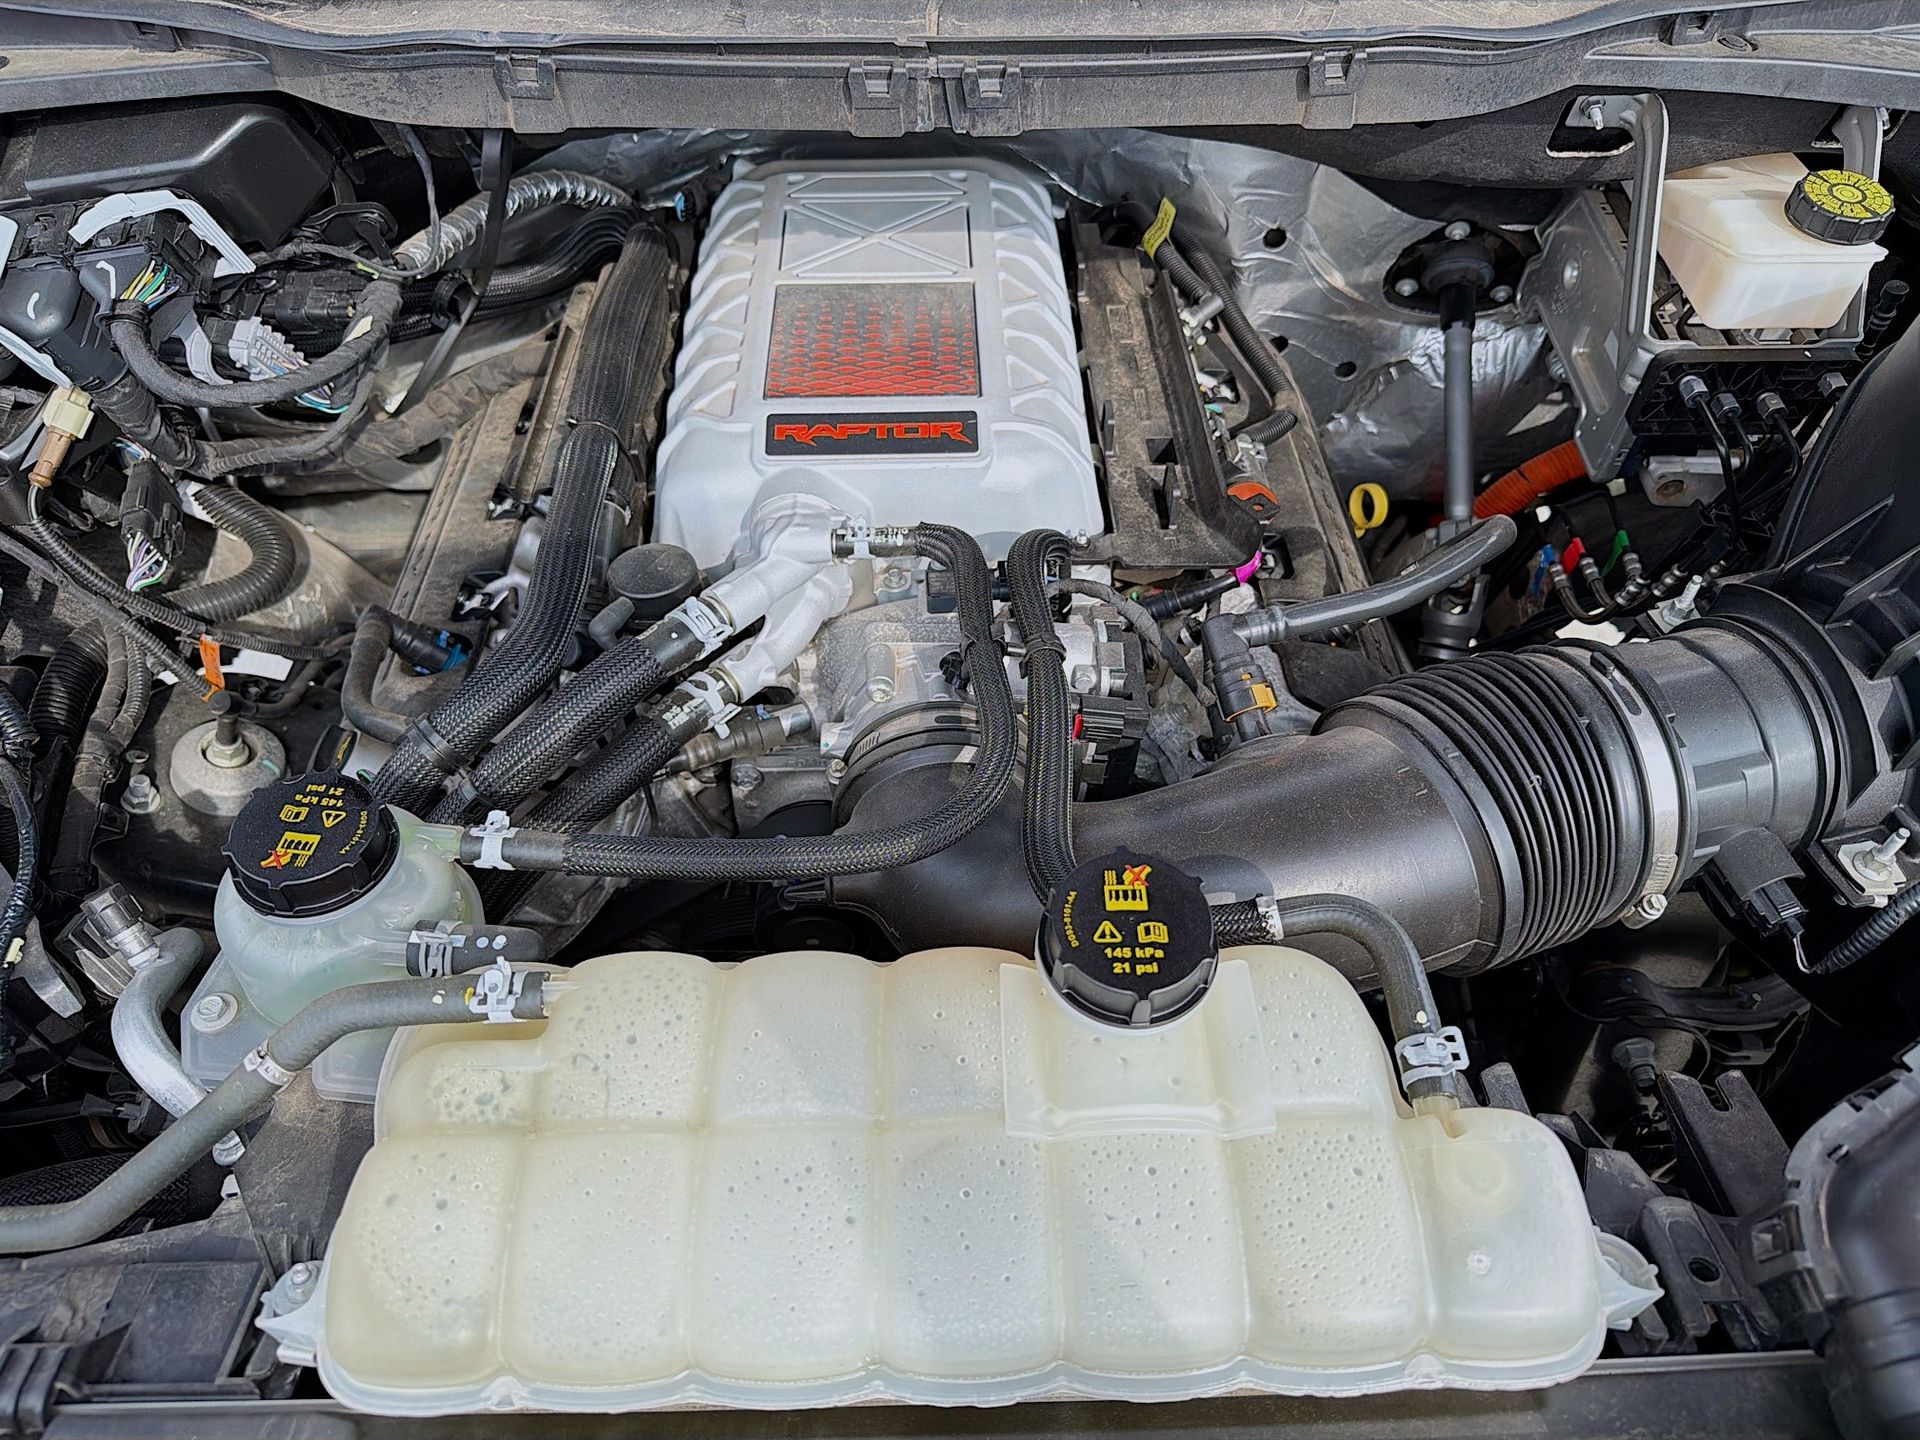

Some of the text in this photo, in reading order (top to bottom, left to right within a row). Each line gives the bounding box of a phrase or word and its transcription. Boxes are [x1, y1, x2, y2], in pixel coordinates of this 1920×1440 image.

[774, 421, 973, 447] RAPTOR
[306, 784, 344, 796] 21 psi
[295, 794, 344, 807] 145 kPa
[1104, 946, 1165, 959] 145 kPa
[1112, 961, 1159, 976] 21 psi
